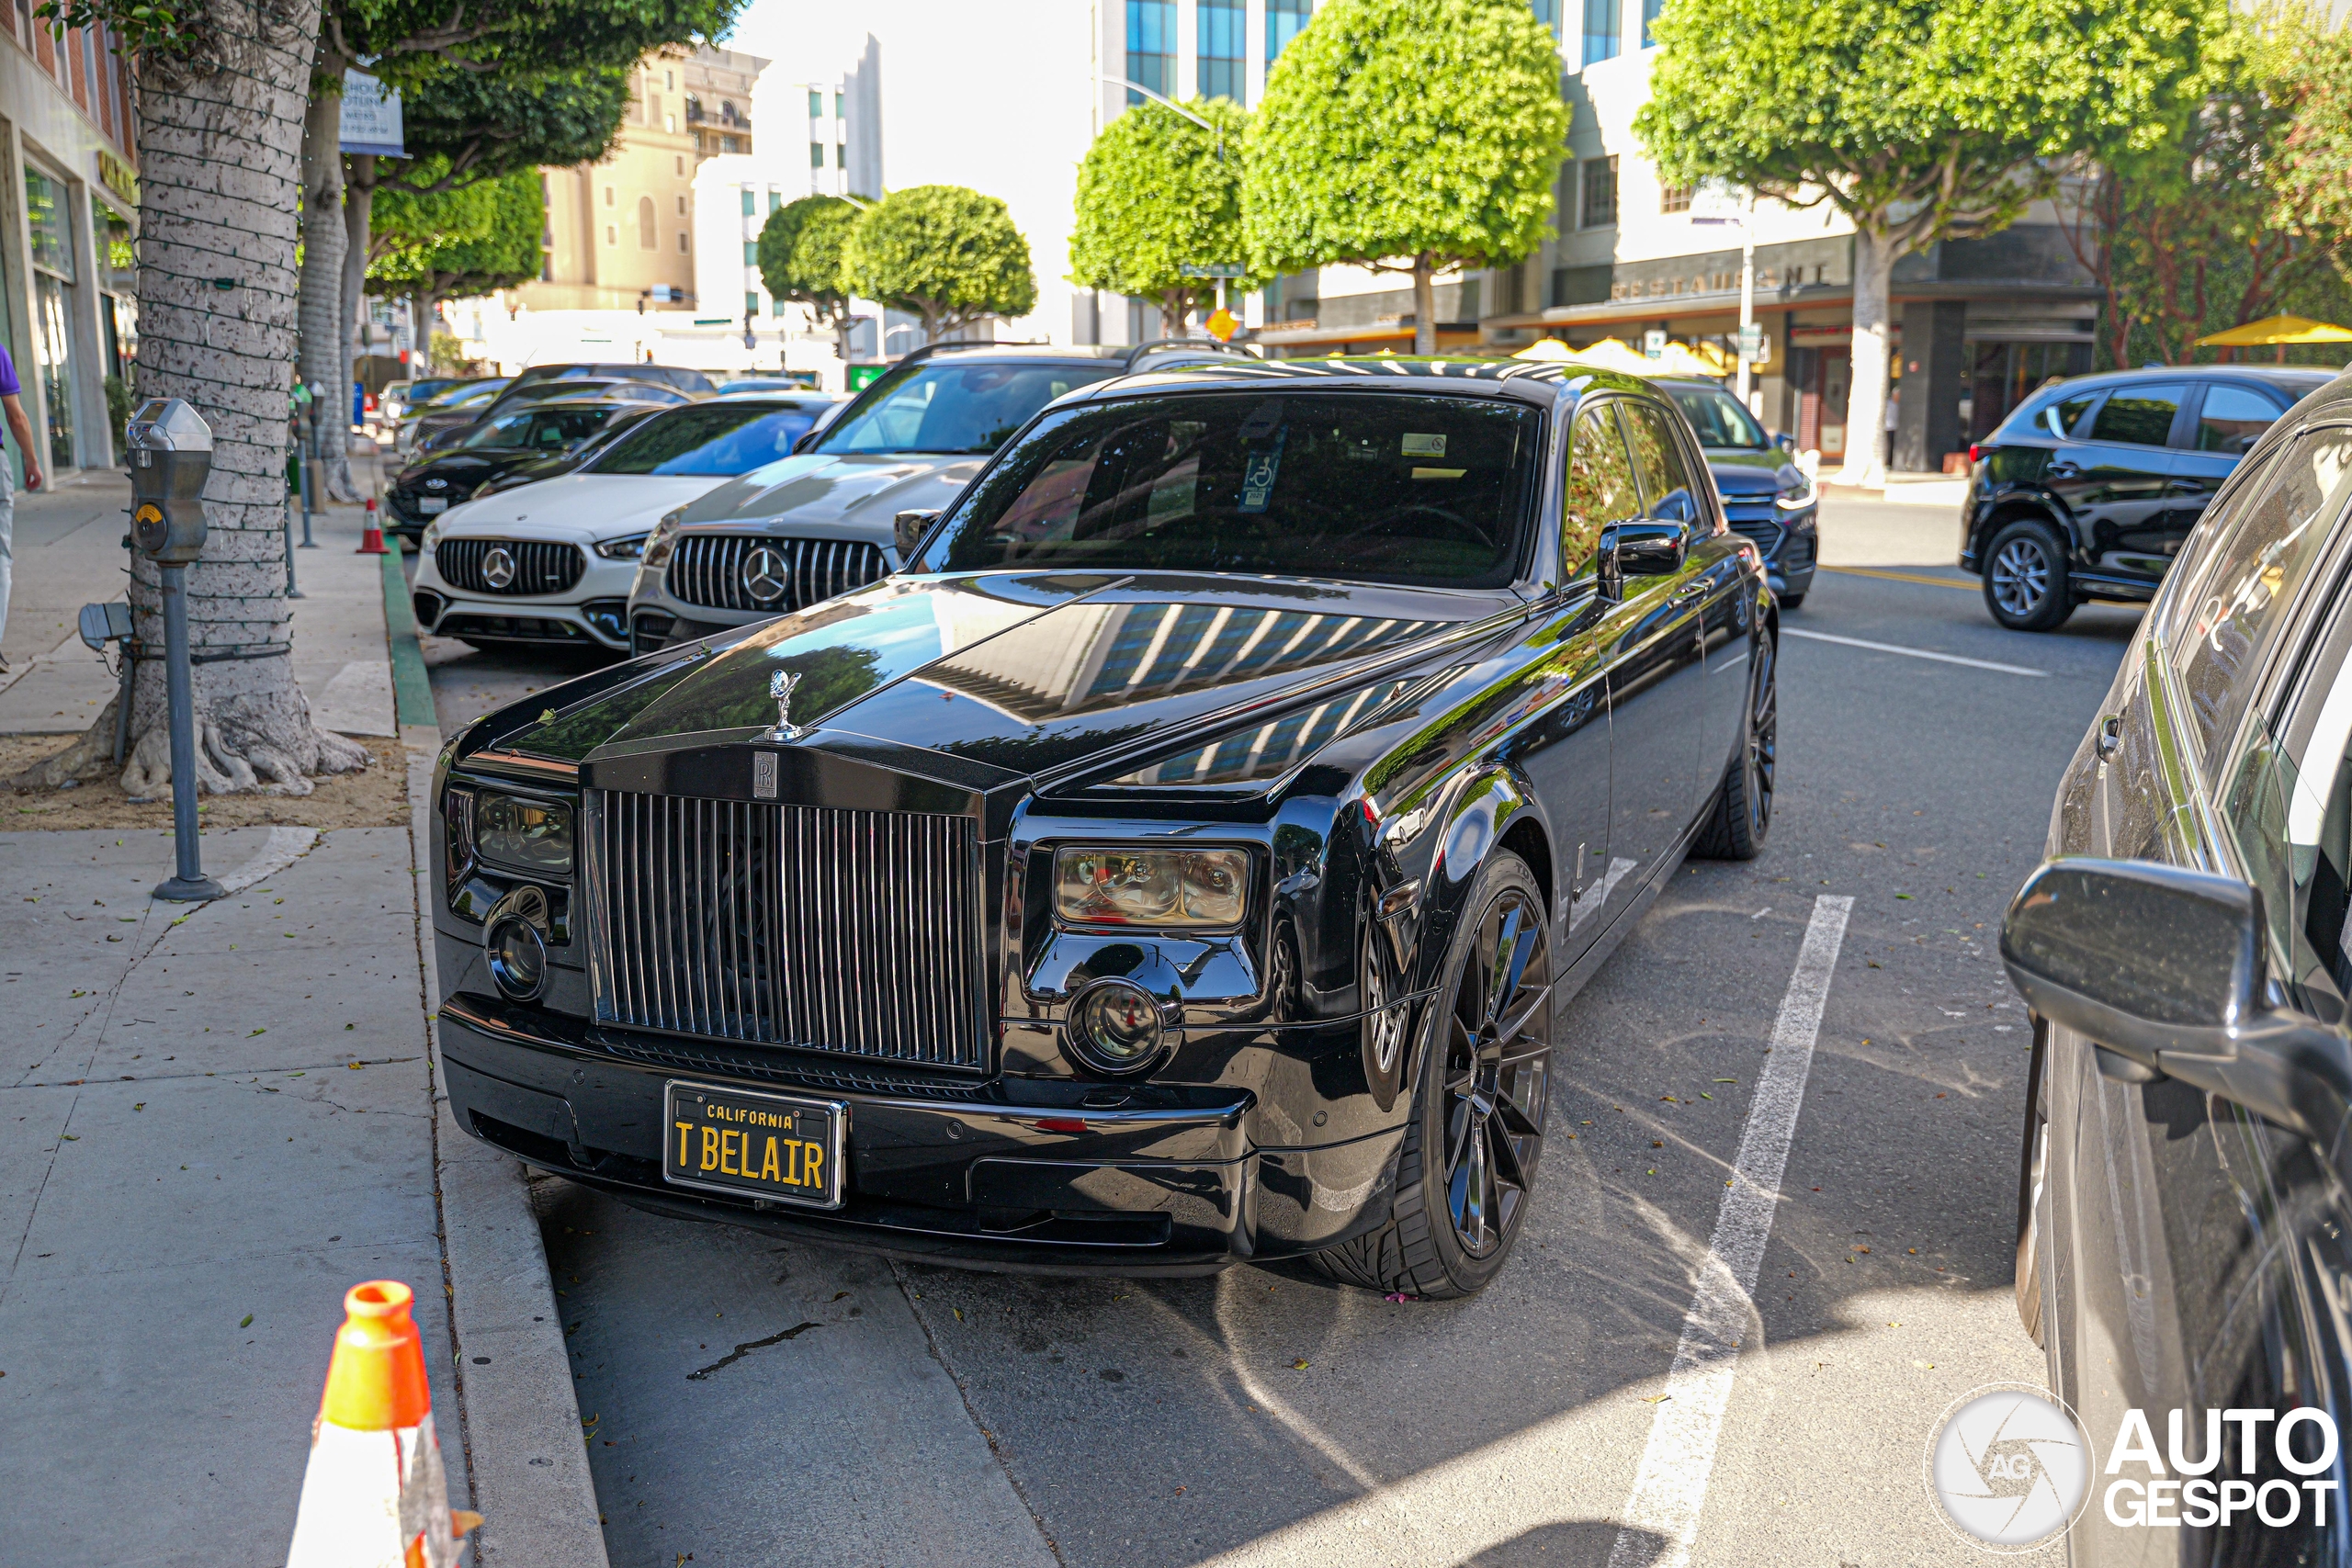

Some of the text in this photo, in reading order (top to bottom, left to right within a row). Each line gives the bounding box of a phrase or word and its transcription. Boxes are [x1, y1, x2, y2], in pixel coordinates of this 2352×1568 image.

[1515, 861, 1542, 900] TOYO
[707, 1104, 793, 1130] CALIFORNIA
[675, 1122, 824, 1189] T BELAIR
